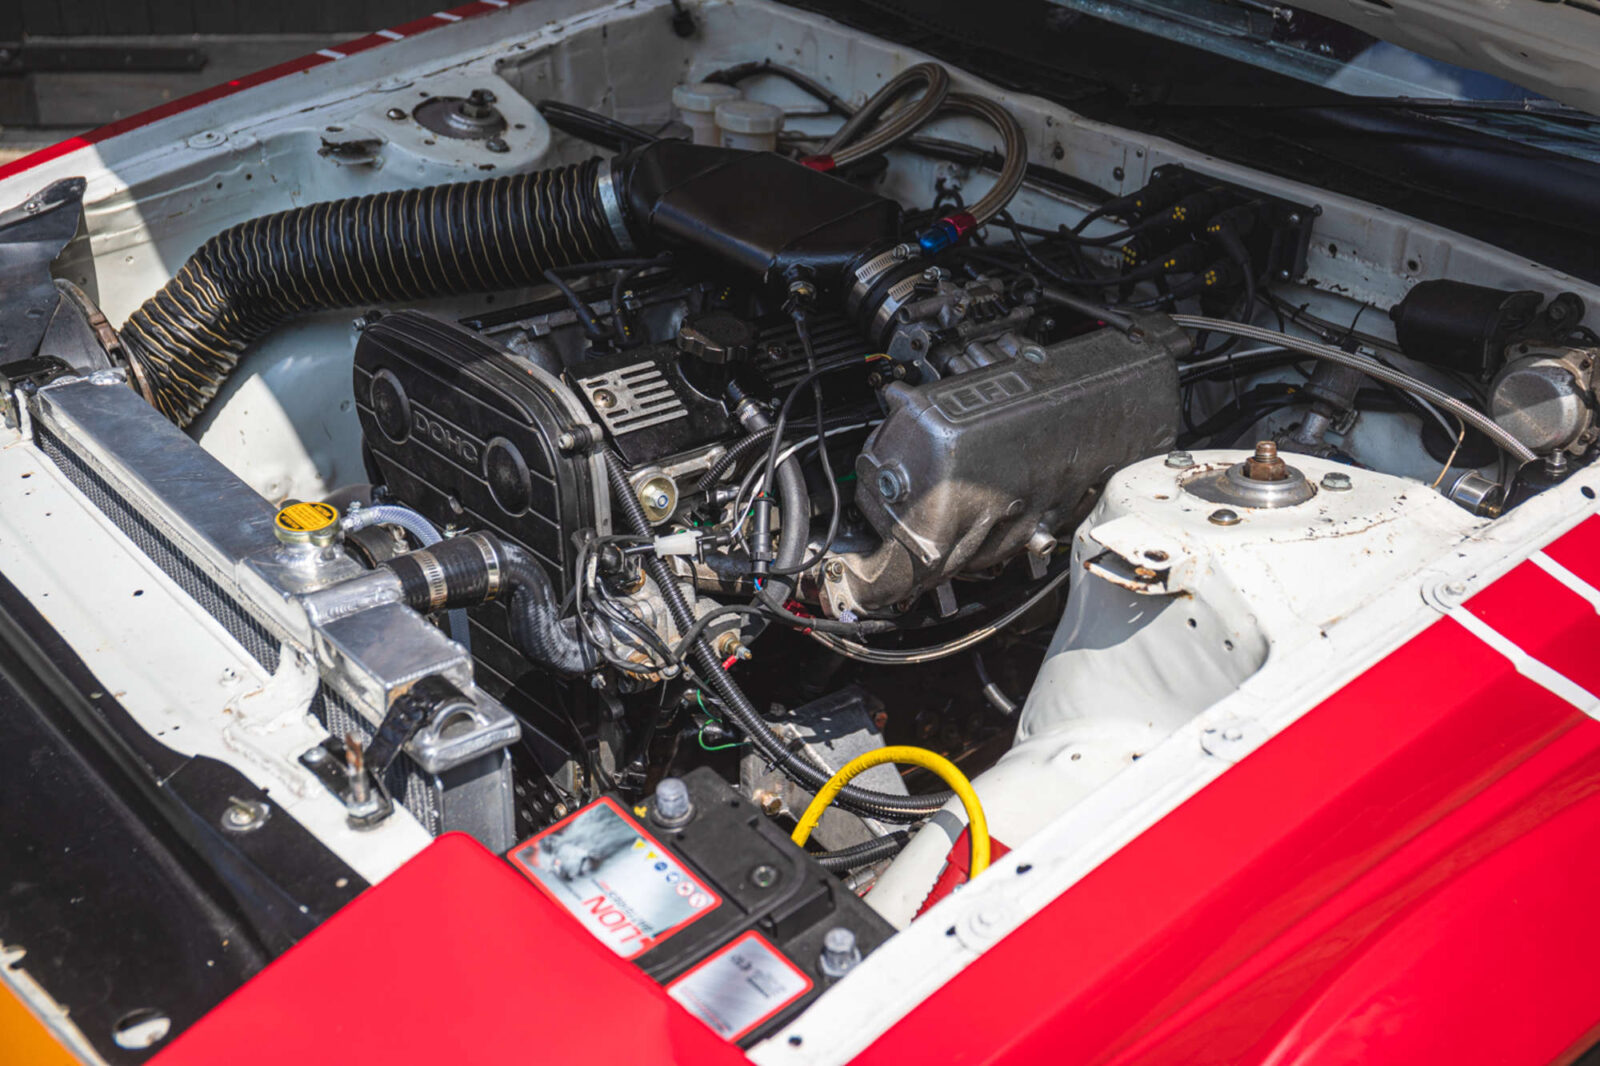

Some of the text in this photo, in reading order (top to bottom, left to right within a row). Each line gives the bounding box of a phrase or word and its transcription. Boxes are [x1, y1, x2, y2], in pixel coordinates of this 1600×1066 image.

[942, 375, 1016, 413] EFI
[412, 409, 479, 464] DOHC
[582, 895, 642, 943] LION
